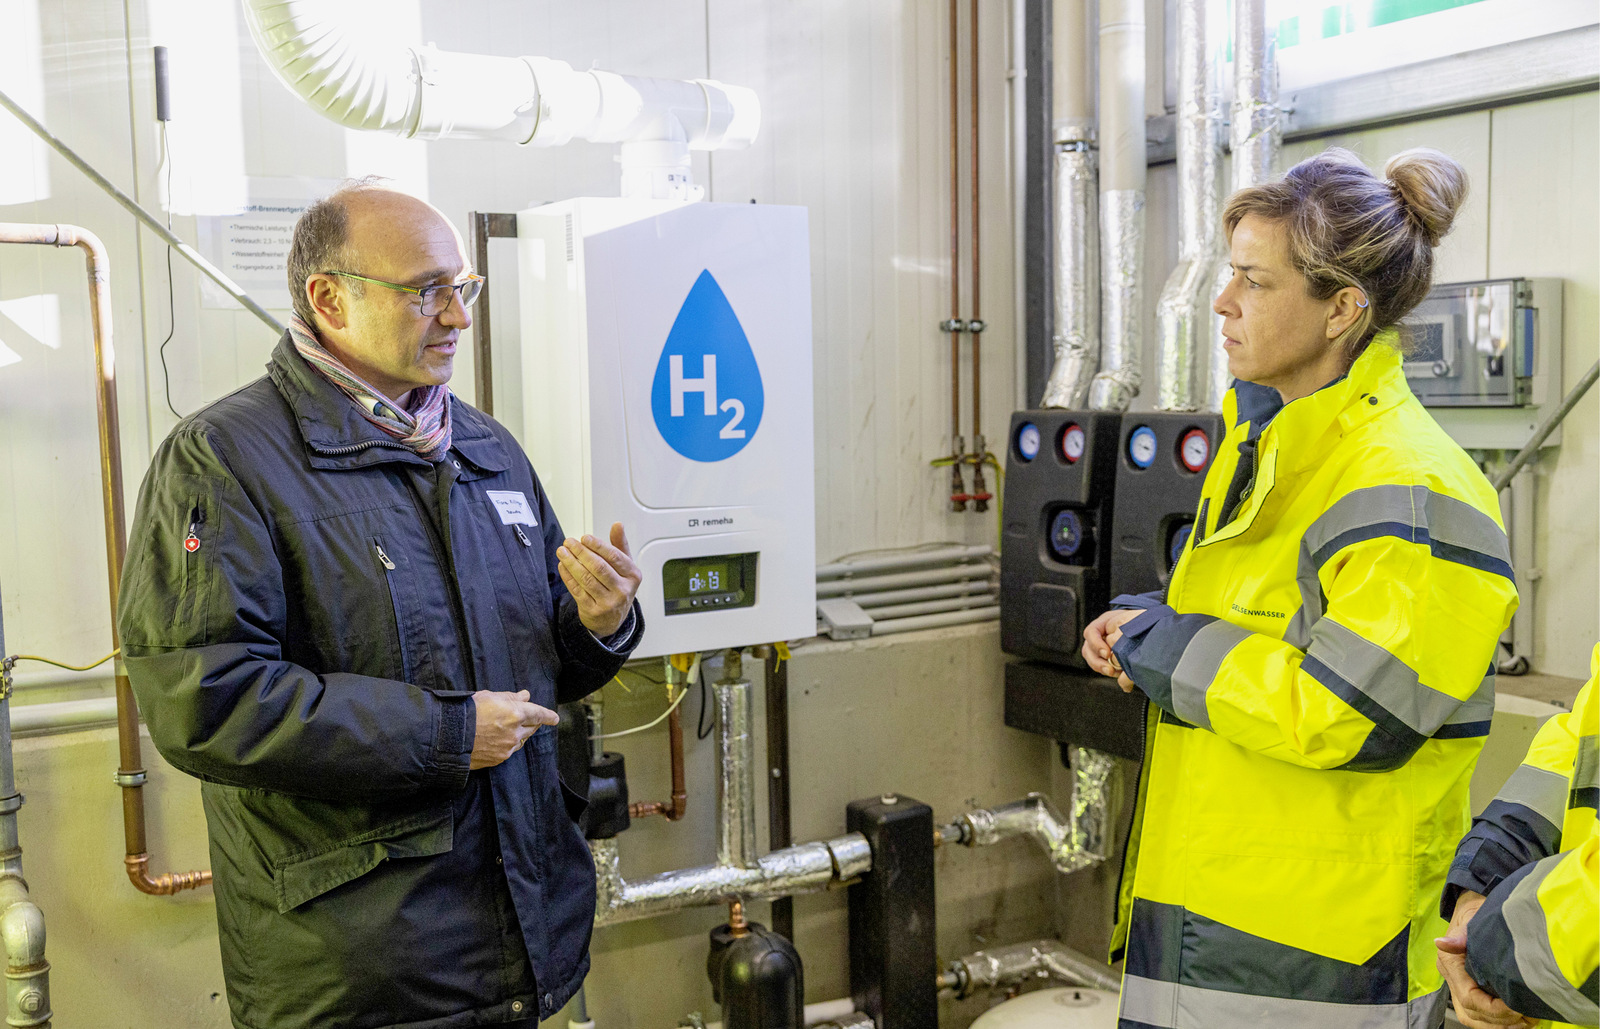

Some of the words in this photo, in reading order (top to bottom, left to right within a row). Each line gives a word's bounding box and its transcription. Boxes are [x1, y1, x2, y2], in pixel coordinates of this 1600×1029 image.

[669, 354, 746, 440] H2
[702, 517, 734, 526] remeha
[1231, 603, 1286, 619] GELSENWASSER
